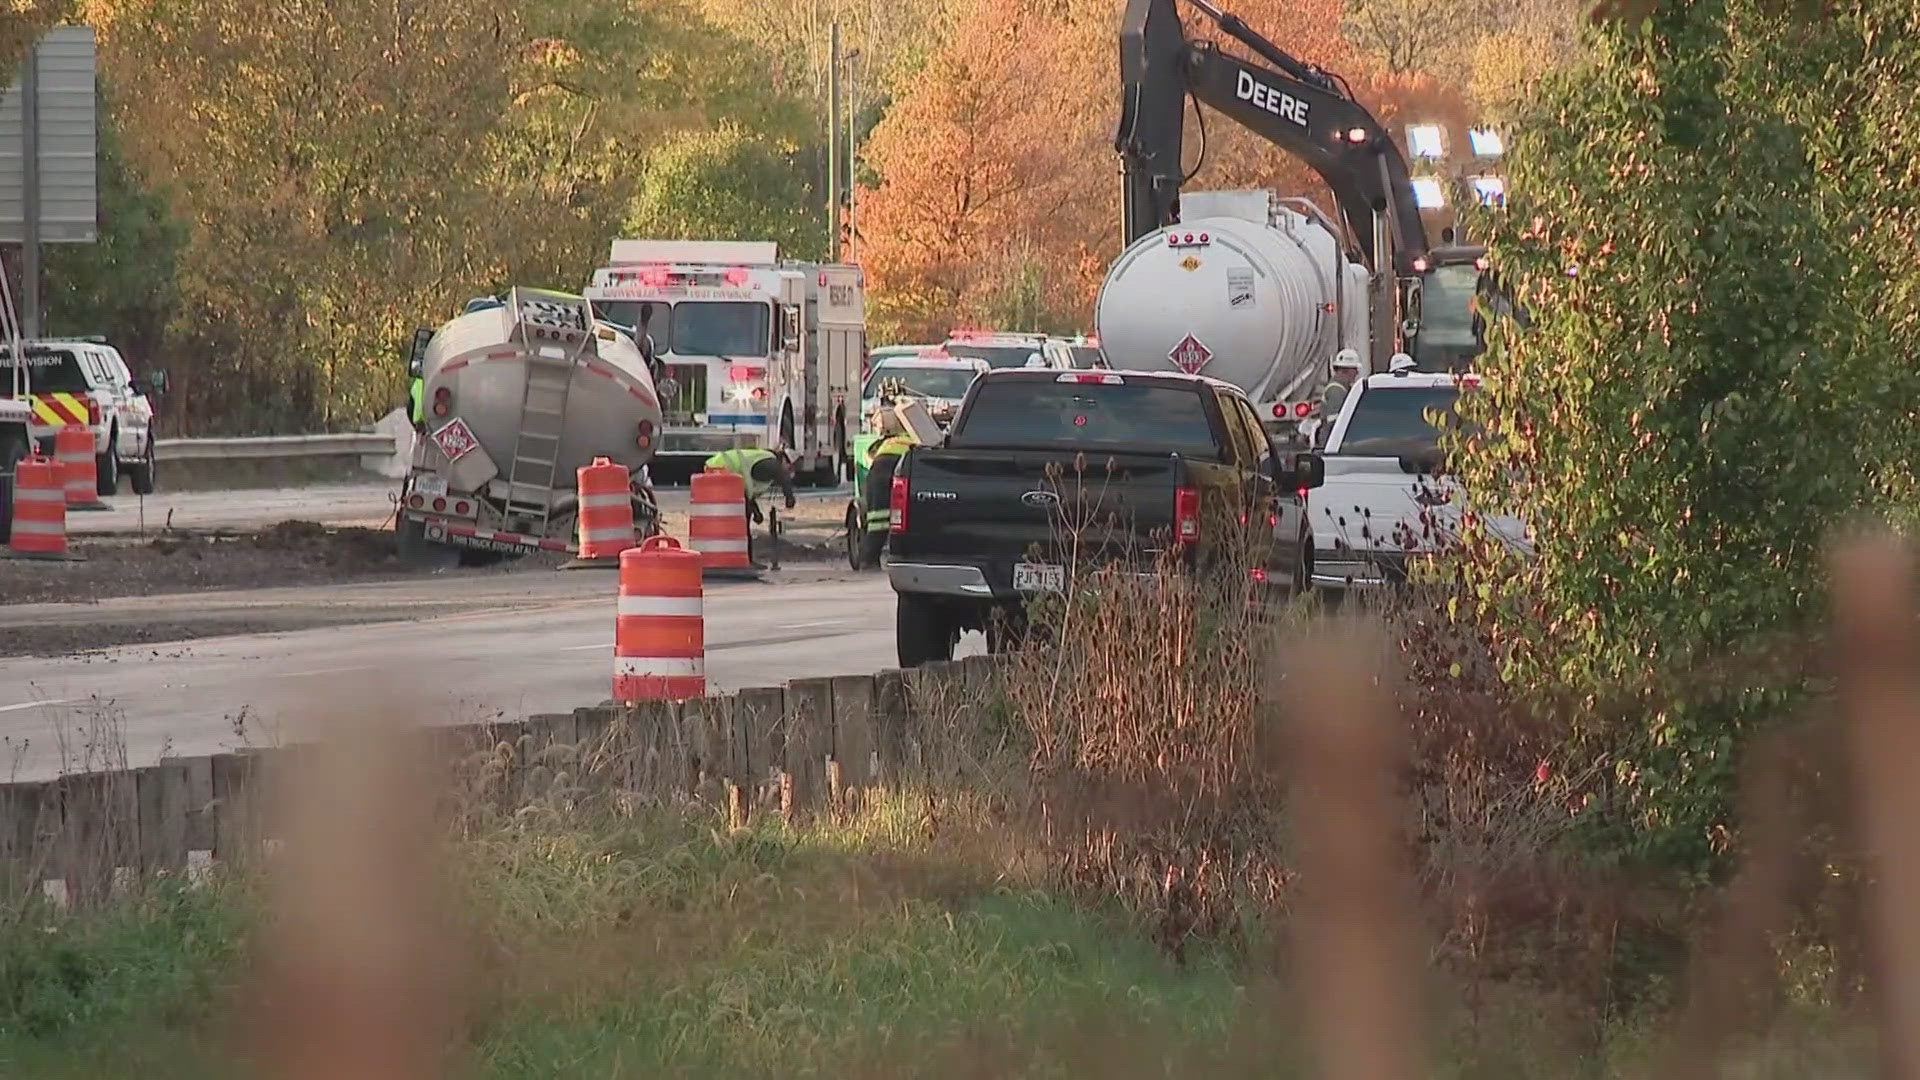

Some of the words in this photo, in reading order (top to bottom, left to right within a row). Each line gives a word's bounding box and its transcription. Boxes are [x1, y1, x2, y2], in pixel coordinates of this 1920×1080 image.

[1237, 69, 1309, 126] DEERE
[469, 537, 491, 549] TRUCK
[492, 541, 514, 552] STOPS
[515, 544, 524, 553] AT
